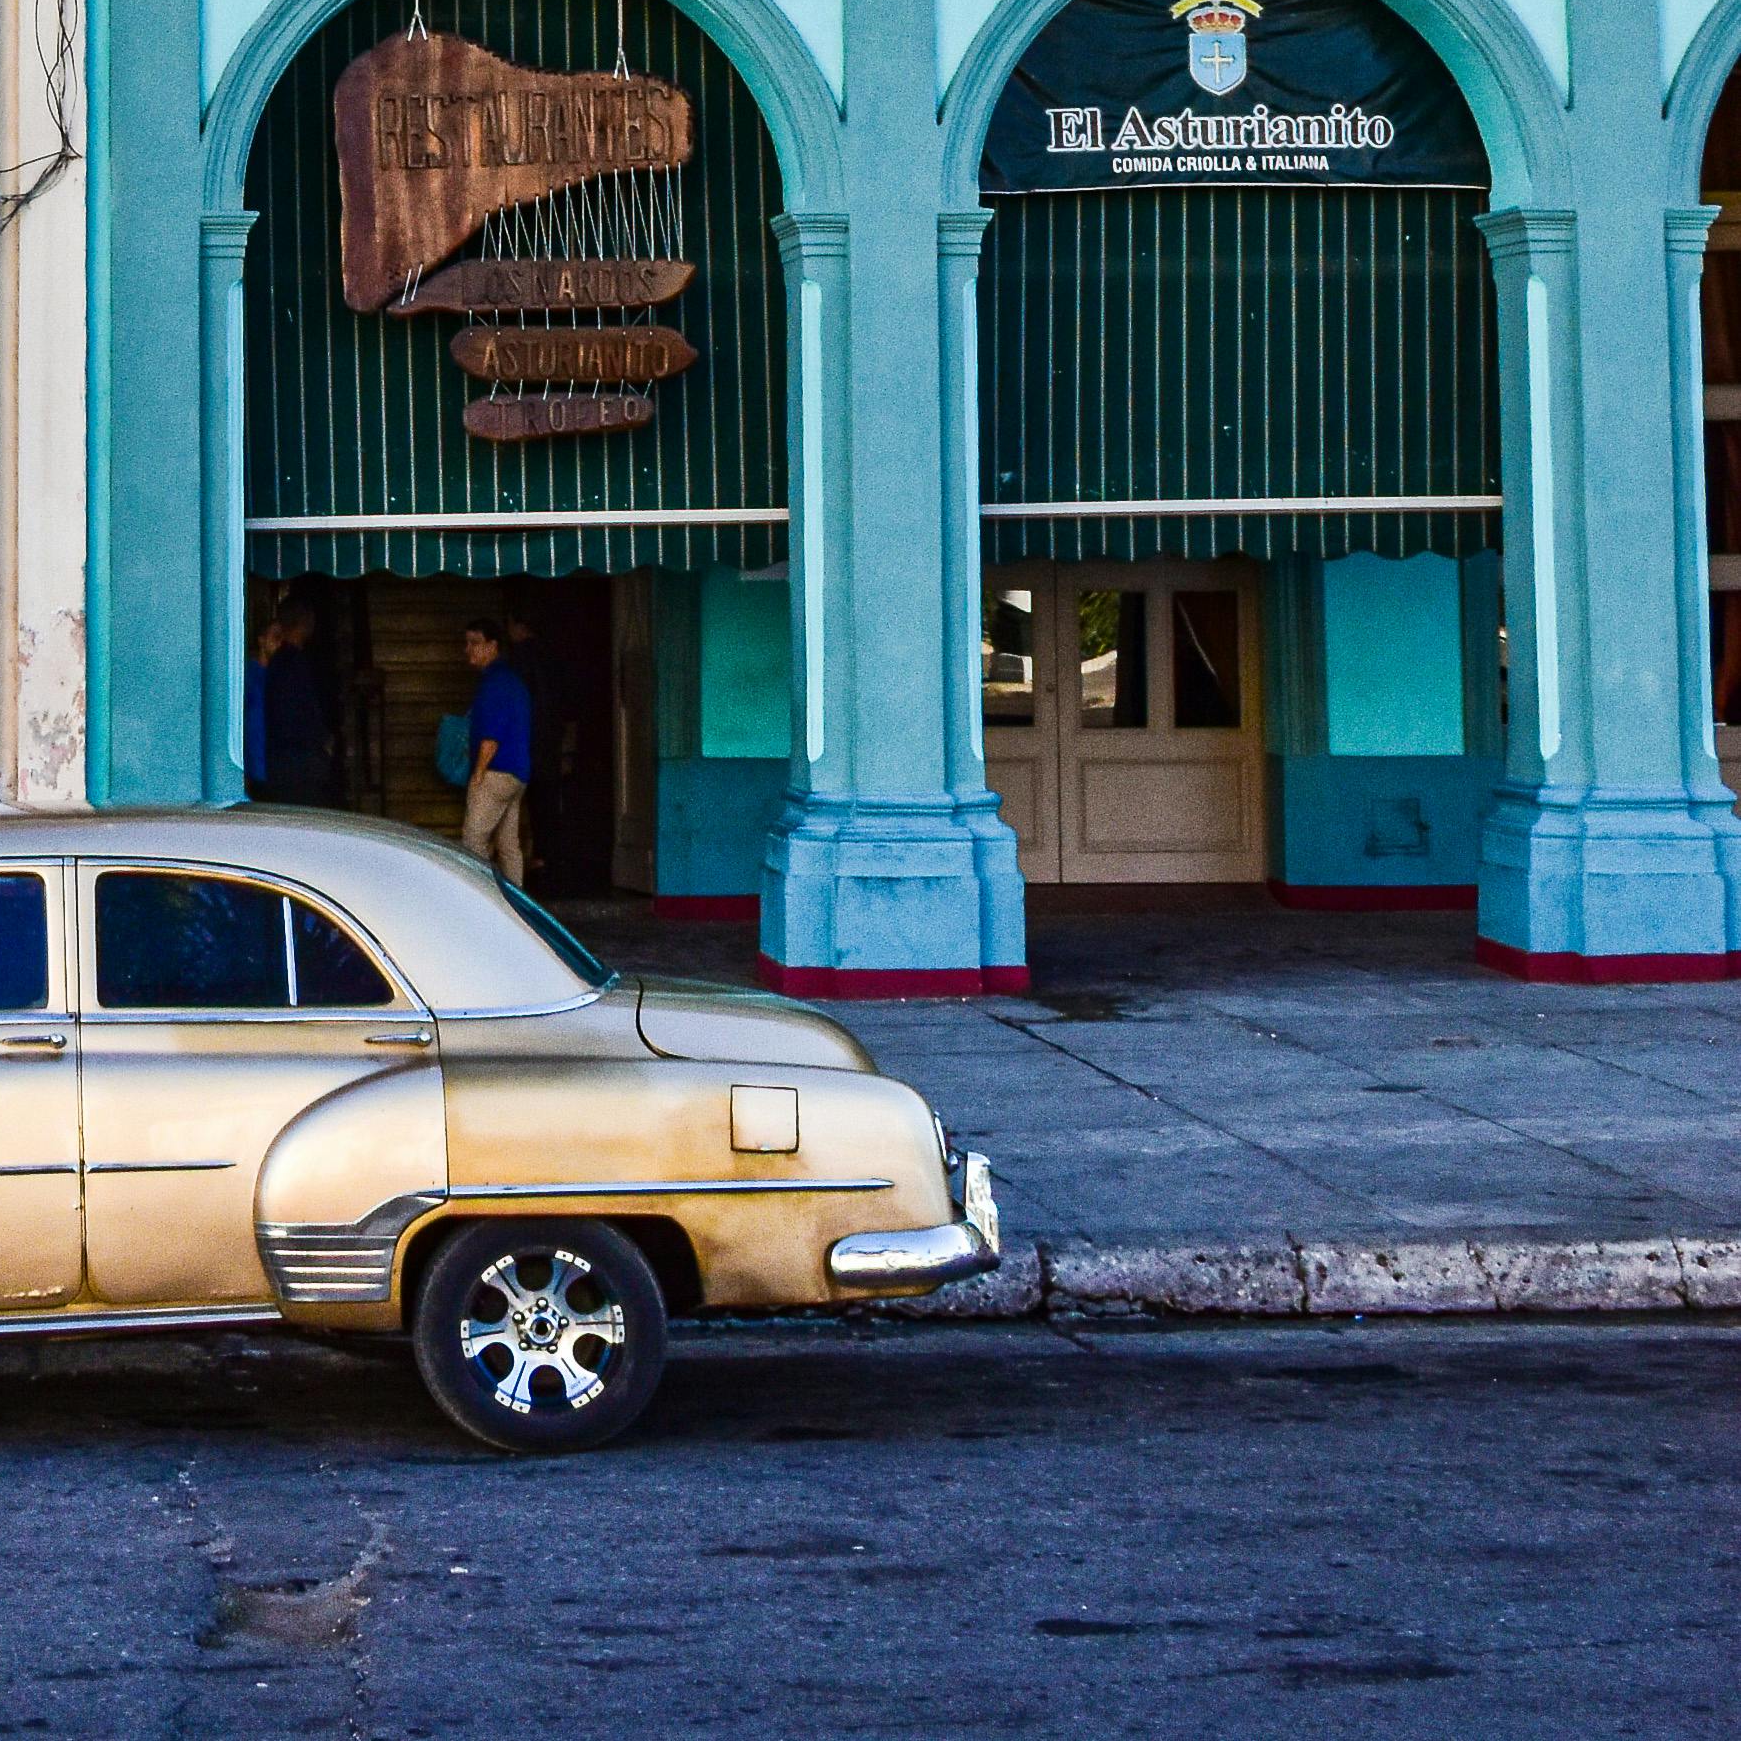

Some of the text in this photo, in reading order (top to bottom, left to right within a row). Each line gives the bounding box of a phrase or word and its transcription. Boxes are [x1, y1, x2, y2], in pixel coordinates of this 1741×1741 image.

[377, 87, 674, 168] RESTAURANTES
[1045, 103, 1394, 152] El Asturianito
[1112, 155, 1330, 174] COMIDA CRIOLLA & ITALIANA
[461, 264, 659, 306] LOS NARDOS
[482, 336, 669, 377] ASTURIANITO
